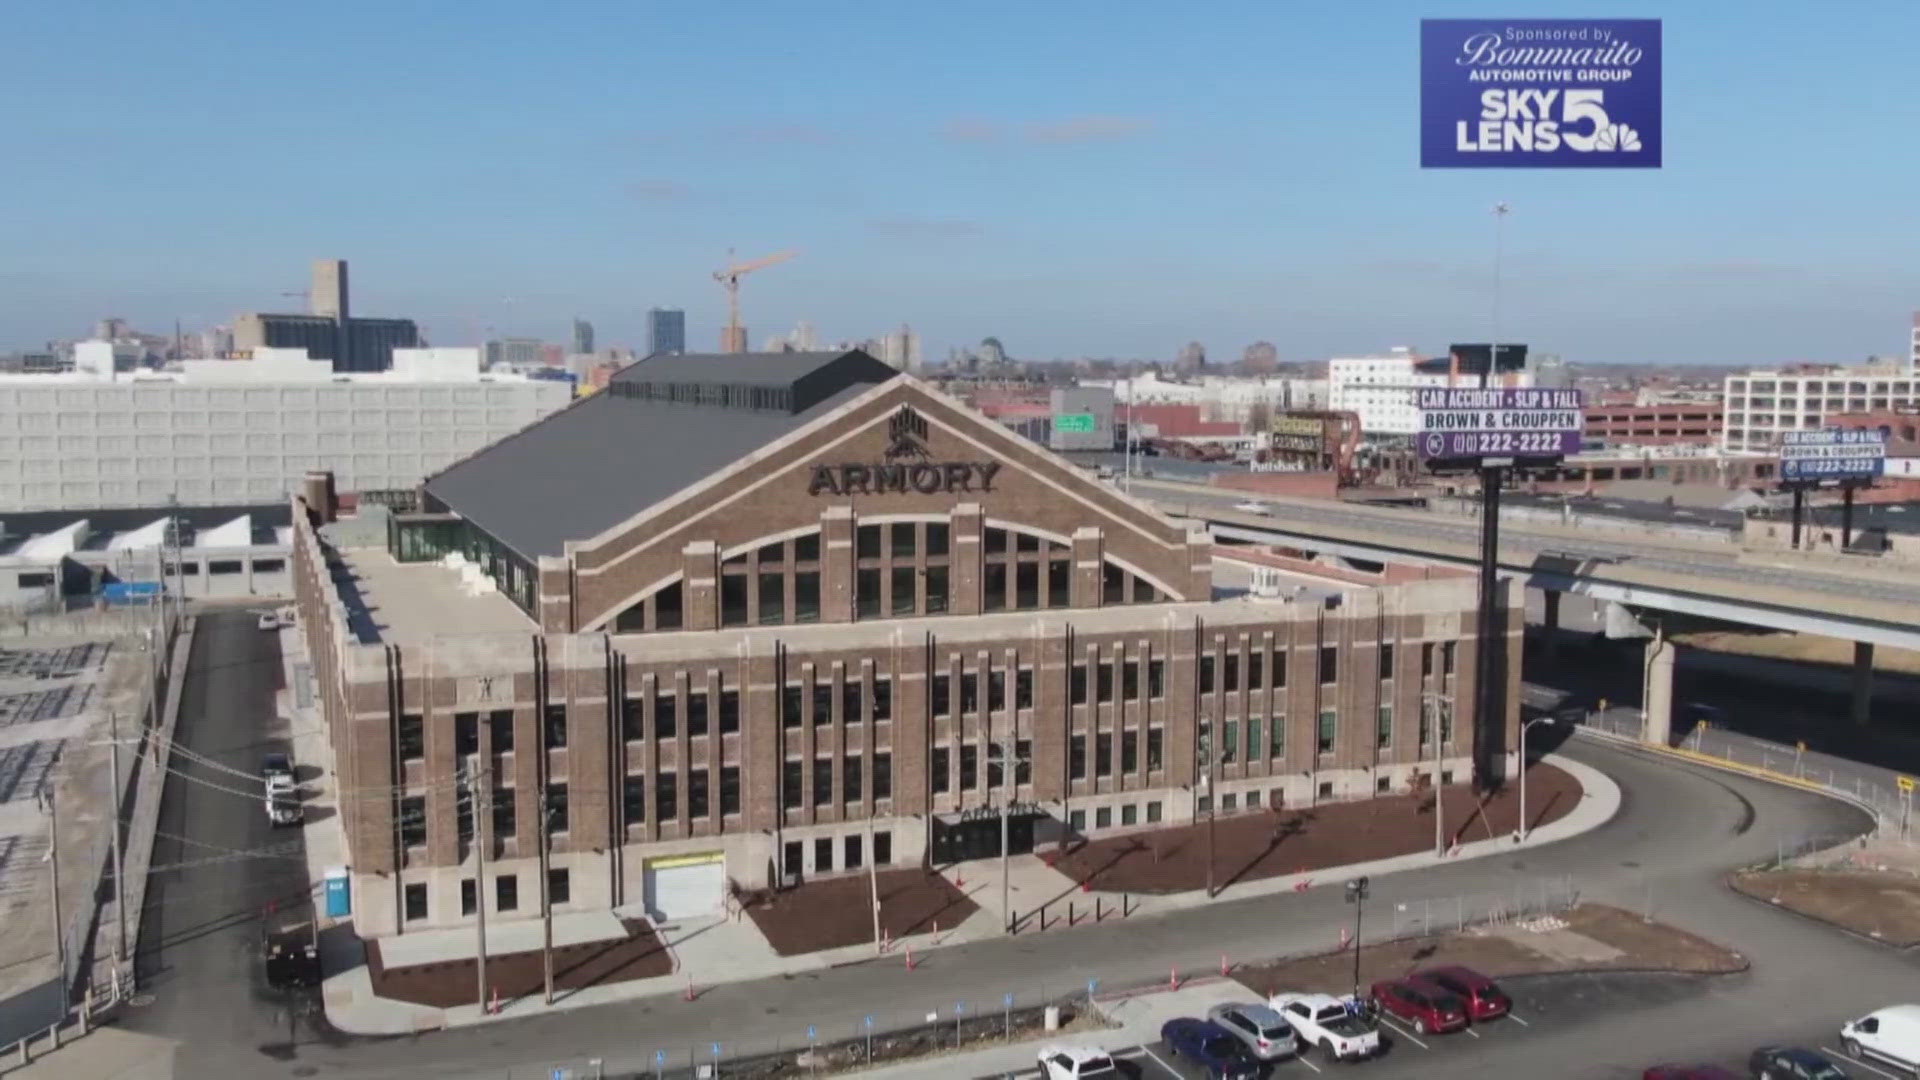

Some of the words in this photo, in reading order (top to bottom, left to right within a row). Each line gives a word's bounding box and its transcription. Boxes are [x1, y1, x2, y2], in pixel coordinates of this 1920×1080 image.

[1421, 390, 1445, 408] CAR
[1448, 390, 1504, 408] ACCIDENT
[1515, 390, 1540, 408] SLIP
[1541, 390, 1550, 408] &
[1553, 390, 1579, 408] FALL
[1425, 412, 1480, 428] BROWN
[1485, 412, 1496, 428] &
[1502, 412, 1575, 428] CROUPPEN
[807, 460, 1002, 496] ARMORY
